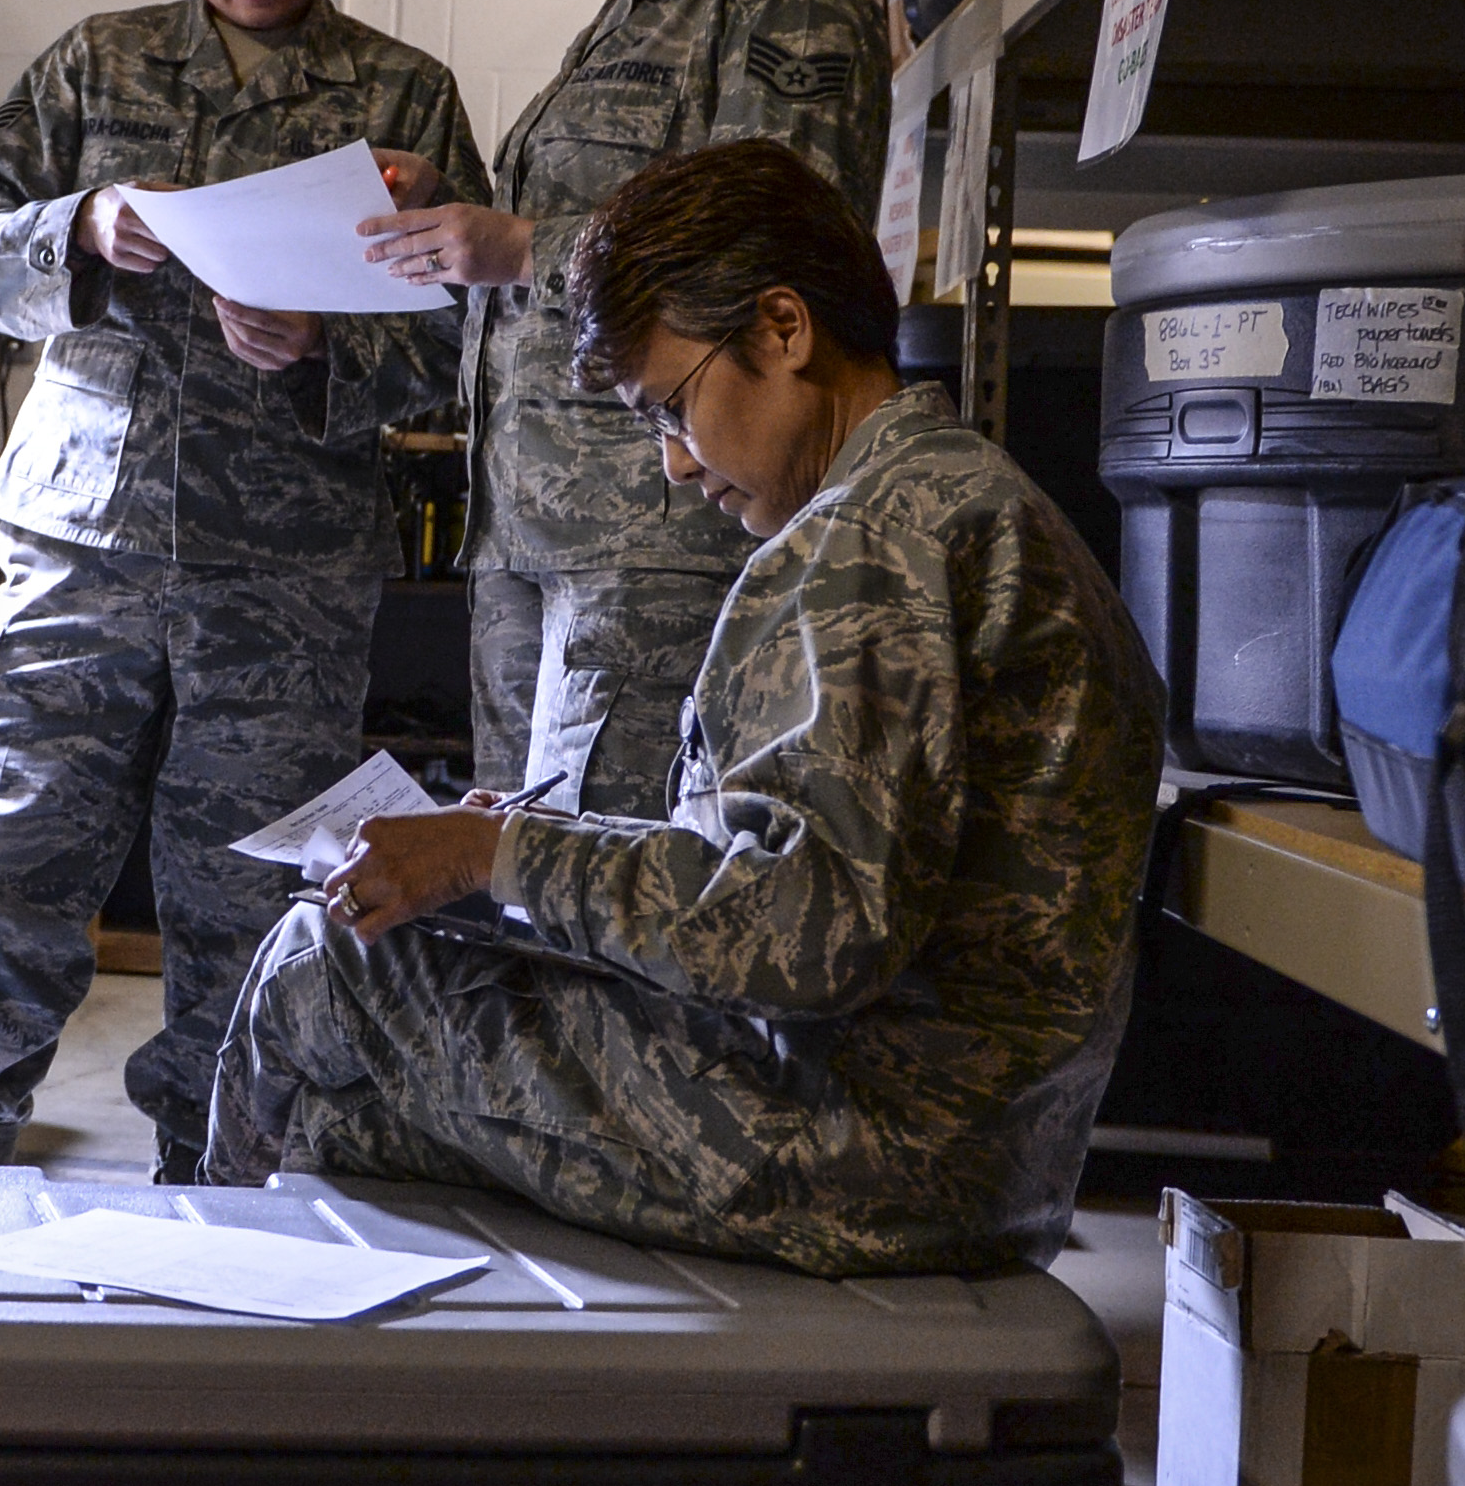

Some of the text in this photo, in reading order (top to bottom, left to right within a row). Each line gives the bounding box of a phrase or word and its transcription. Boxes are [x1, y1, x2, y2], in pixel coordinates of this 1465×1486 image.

[618, 60, 675, 86] FORCE
[1326, 301, 1364, 323] TECH
[1366, 301, 1419, 320] WIPES
[1159, 310, 1268, 343] 886L-1-PT
[1357, 327, 1403, 353] paper
[1168, 346, 1227, 372] Box 35
[1320, 353, 1345, 370] RED
[1357, 375, 1410, 394] BAGS
